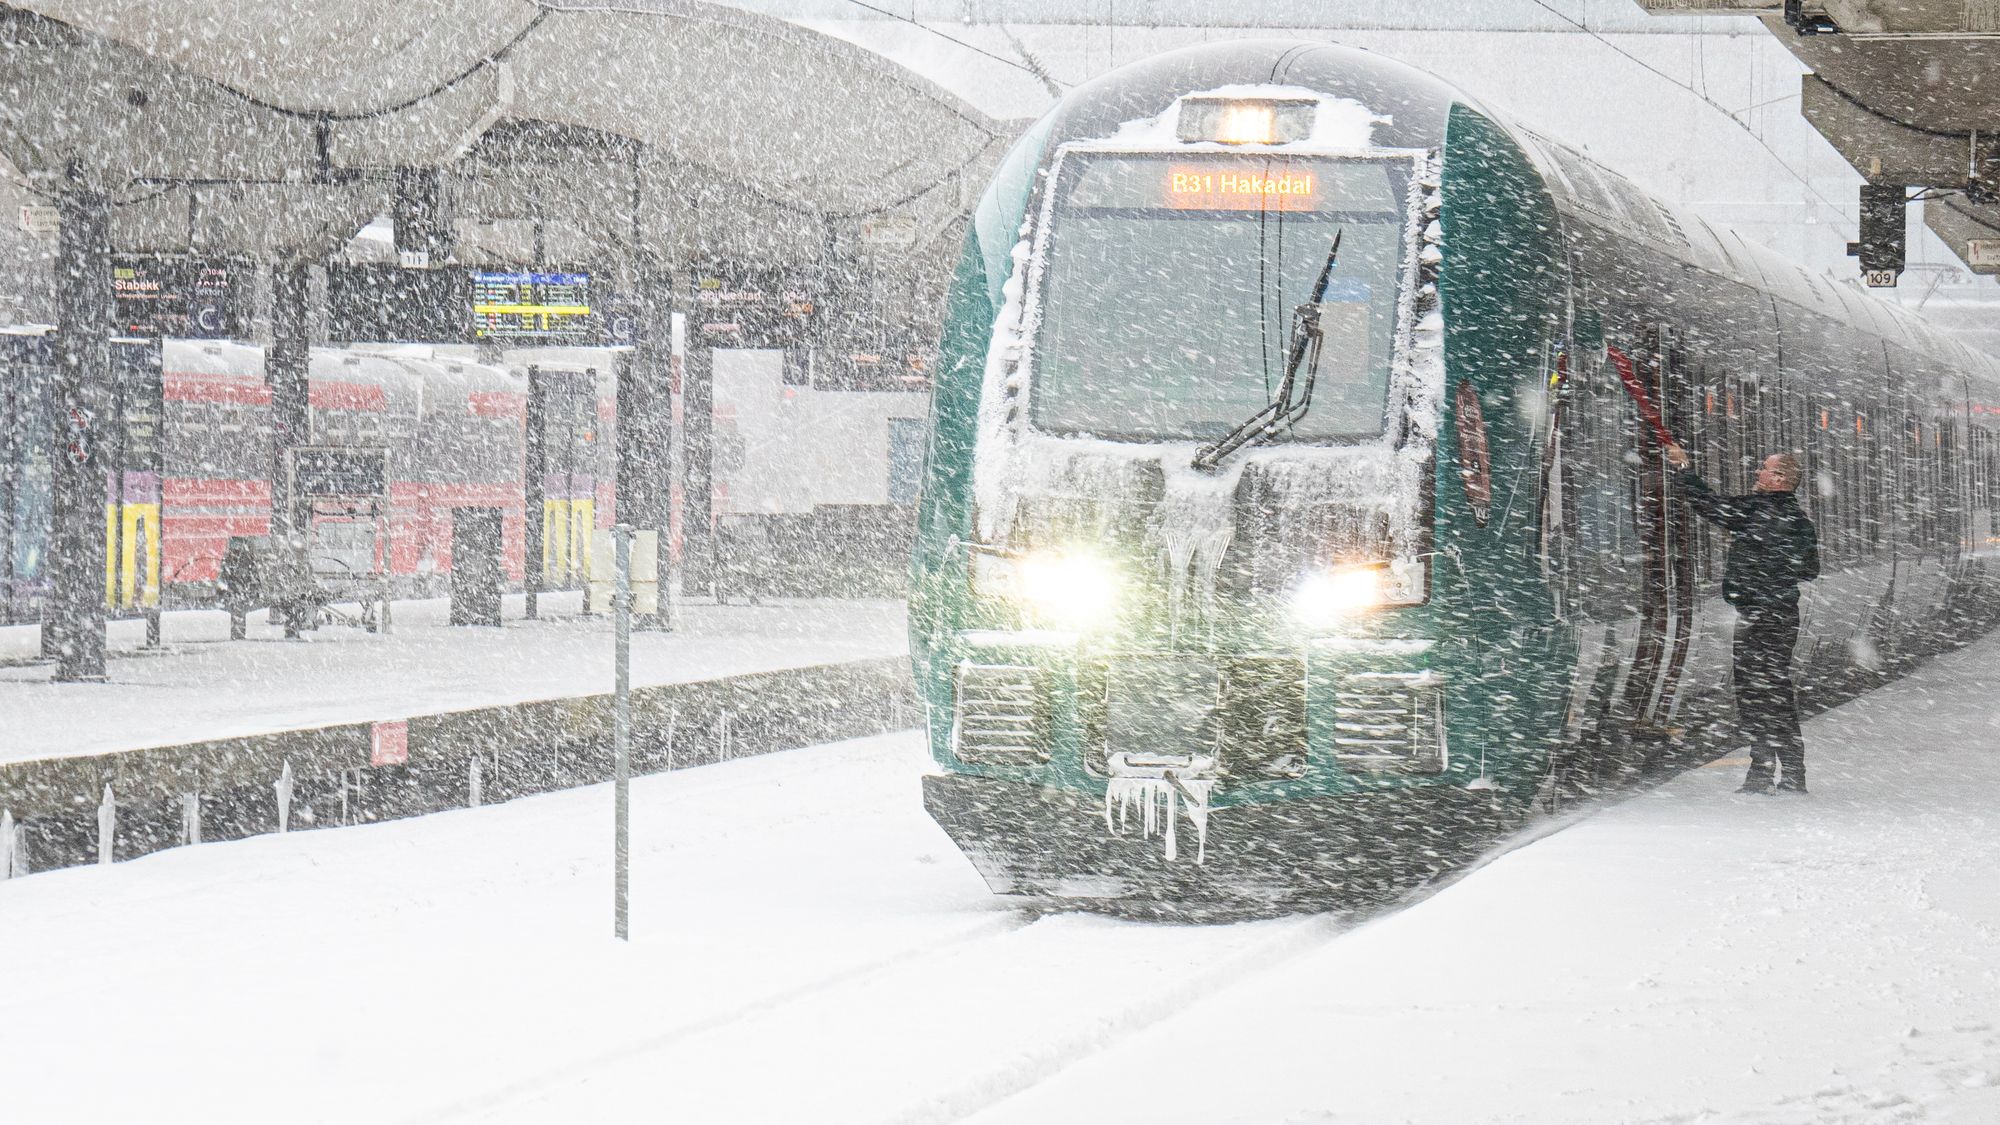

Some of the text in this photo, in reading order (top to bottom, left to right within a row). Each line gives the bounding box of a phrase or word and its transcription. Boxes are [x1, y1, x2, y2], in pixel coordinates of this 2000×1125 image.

[1172, 173, 1312, 195] R31 Hakadal
[115, 279, 160, 291] Stabekk
[1870, 273, 1891, 284] 109
[199, 308, 217, 331] C
